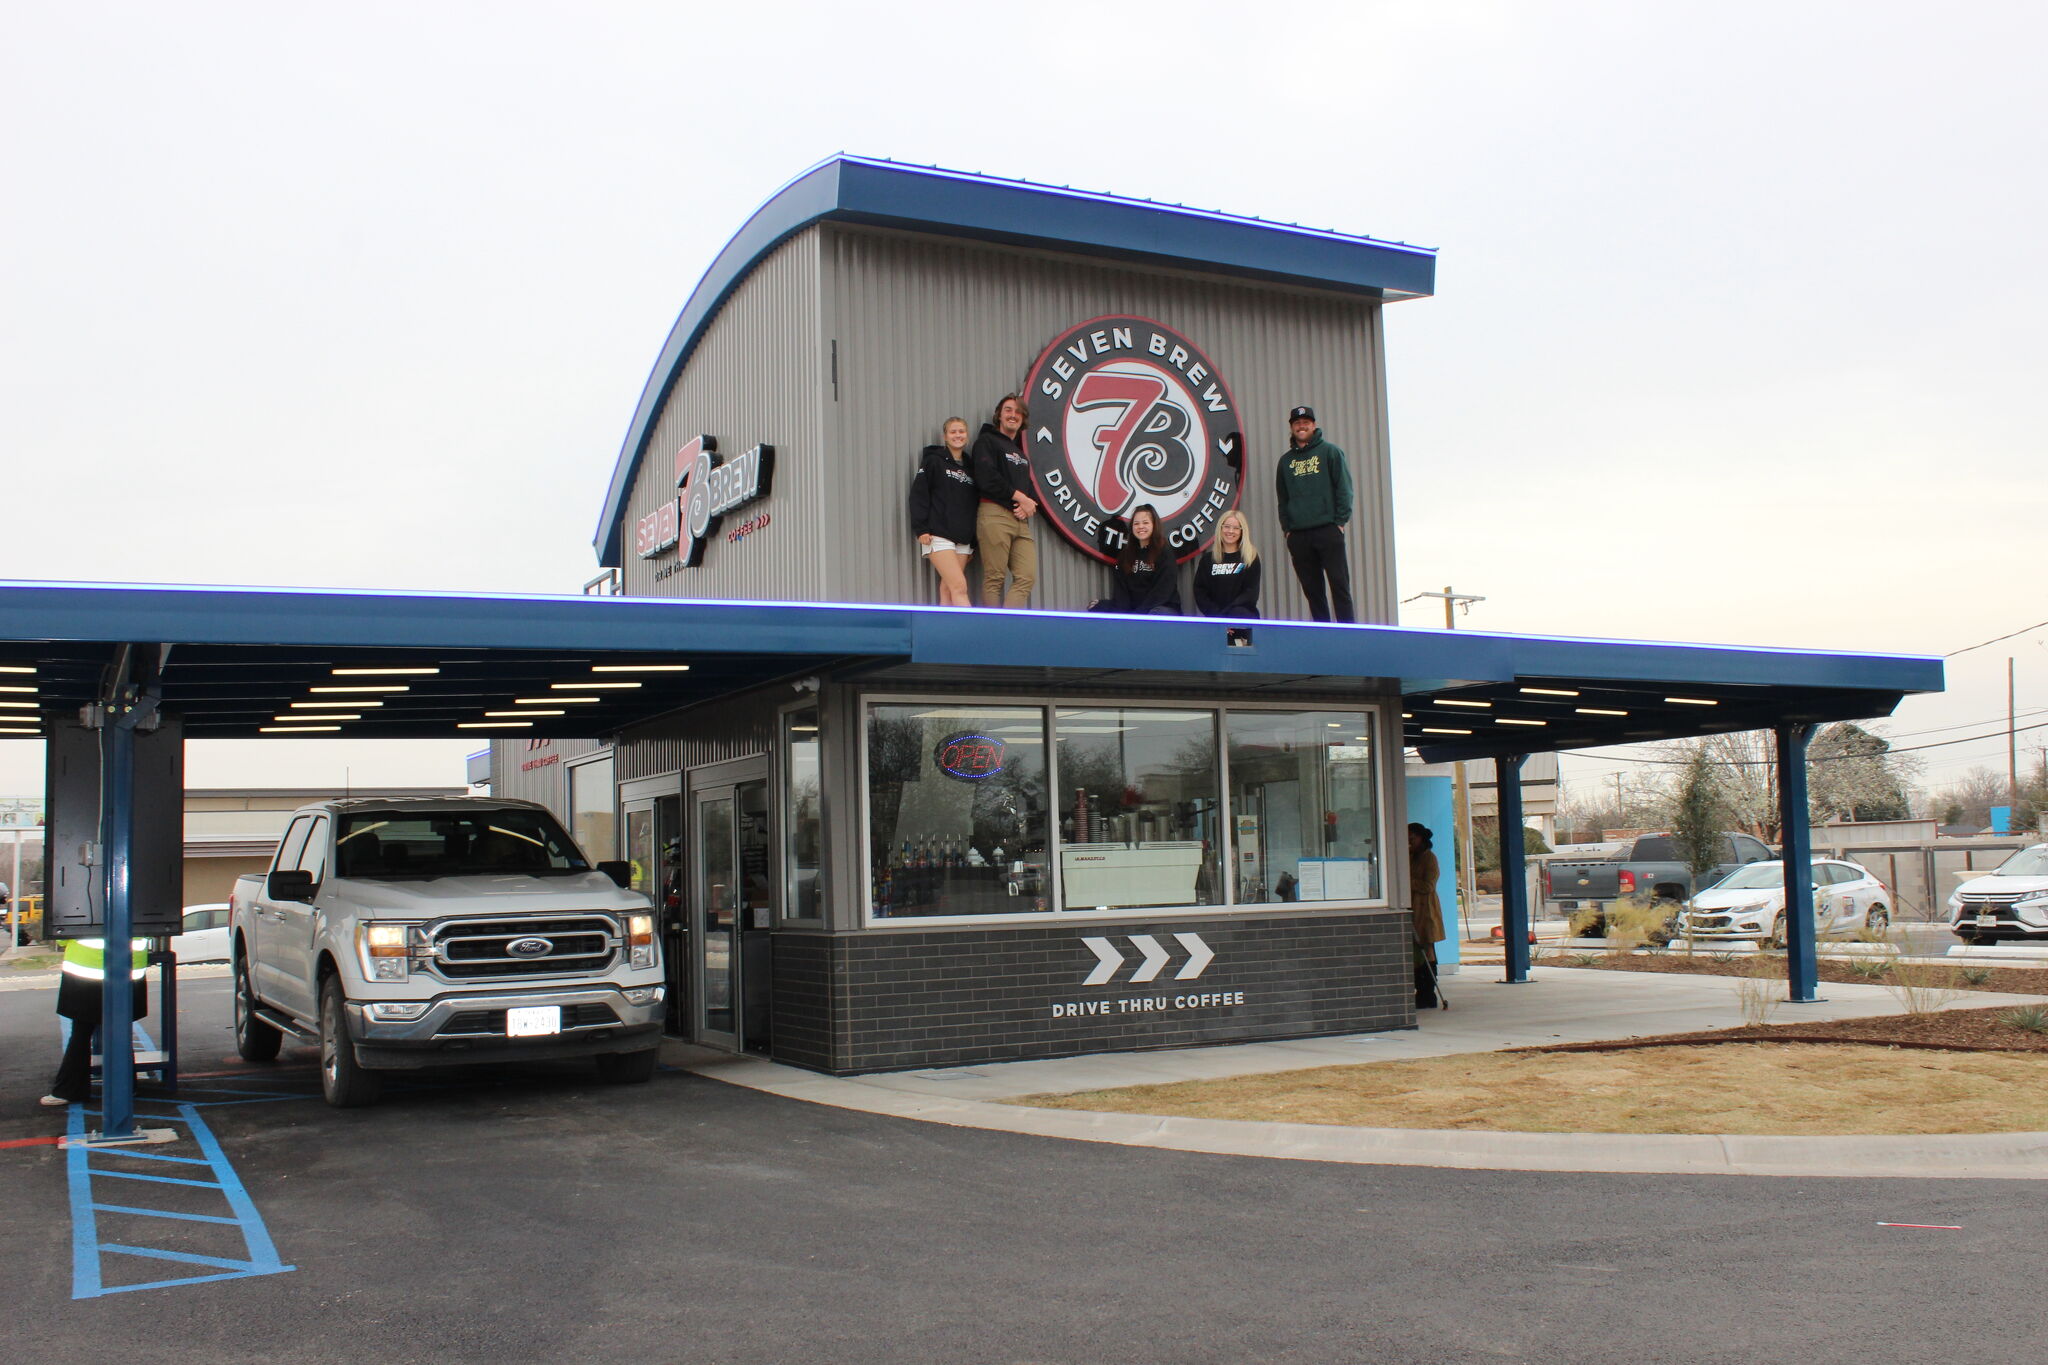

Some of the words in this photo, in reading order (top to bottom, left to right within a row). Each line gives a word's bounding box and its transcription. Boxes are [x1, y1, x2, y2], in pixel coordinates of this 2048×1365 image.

[1042, 327, 1133, 400] SEVEN
[1148, 332, 1228, 413] BREW
[637, 499, 679, 560] SEVEN
[711, 445, 762, 517] BREW
[1045, 468, 1101, 536] DRIVE
[1104, 526, 1128, 550] TH
[1168, 477, 1231, 549] COFFEE
[1211, 568, 1234, 576] CREW
[1212, 562, 1236, 570] BREW
[941, 744, 1005, 769] OPEN
[520, 941, 542, 952] Ford
[1052, 1000, 1111, 1018] DRIVE
[1117, 996, 1167, 1013] THRU
[1174, 991, 1245, 1009] COFFEE
